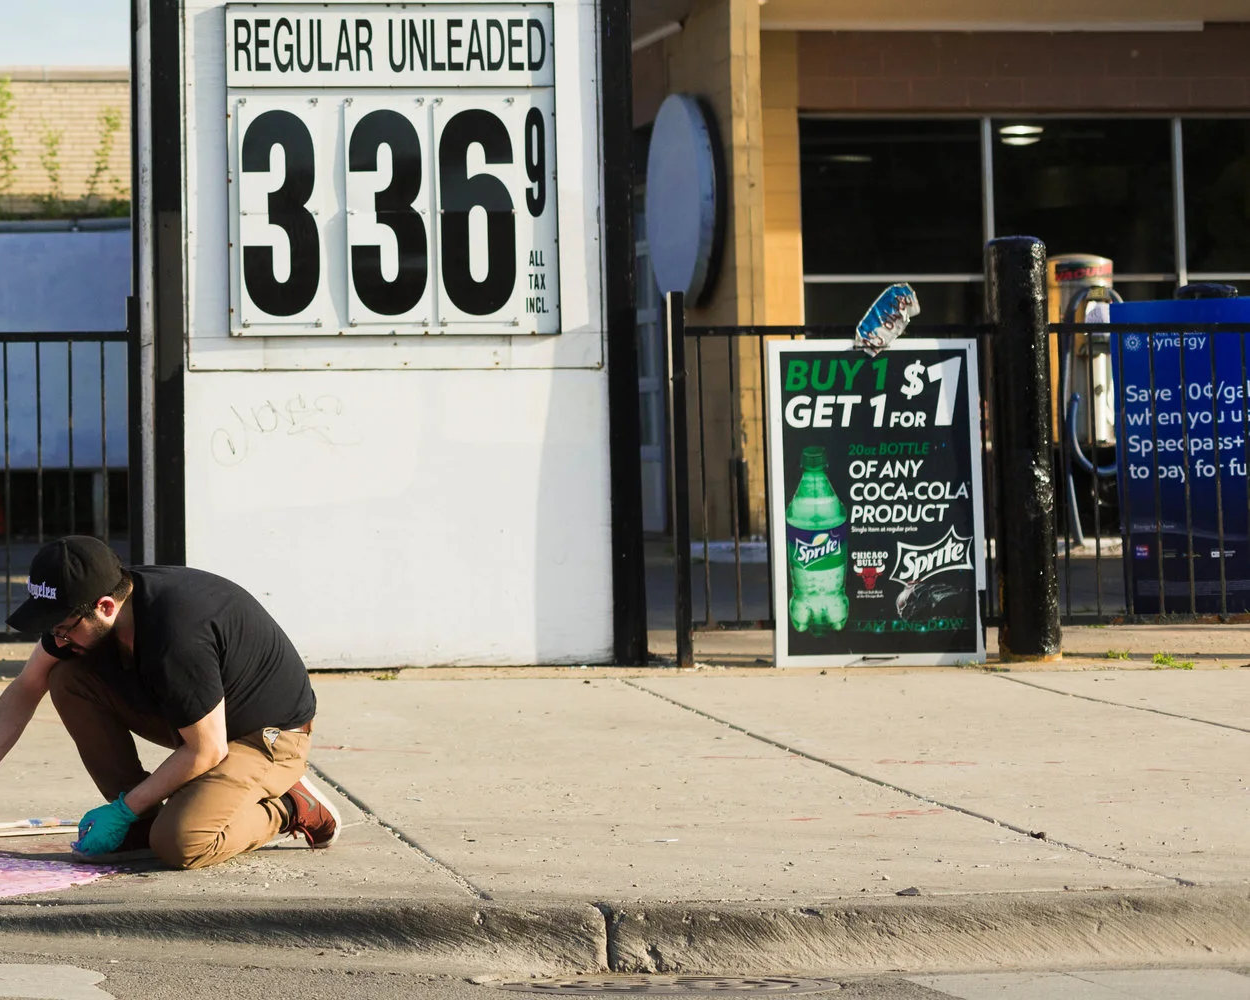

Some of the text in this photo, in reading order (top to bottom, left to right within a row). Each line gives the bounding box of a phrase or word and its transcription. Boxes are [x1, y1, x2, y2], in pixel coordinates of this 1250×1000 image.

[233, 17, 547, 74] REGULAR UNLEADED
[528, 250, 546, 267] ALL
[527, 274, 547, 291] TAX
[525, 297, 550, 314] INCL.
[1146, 336, 1206, 351] Synergy
[785, 357, 889, 391] BUY 1
[1126, 385, 1172, 402] Save
[784, 393, 927, 429] GET 1 FOR
[1127, 408, 1182, 426] when
[1187, 411, 1225, 429] you
[878, 442, 930, 455] BOTTLE
[849, 459, 924, 479] OF ANY
[1129, 463, 1150, 479] to
[850, 481, 969, 502] COCA-COLA
[850, 504, 950, 524] PRODUCT
[797, 540, 838, 564] Sprite
[851, 551, 889, 560] CHICAGO
[856, 559, 883, 567] BULLS
[899, 537, 965, 586] Sprite
